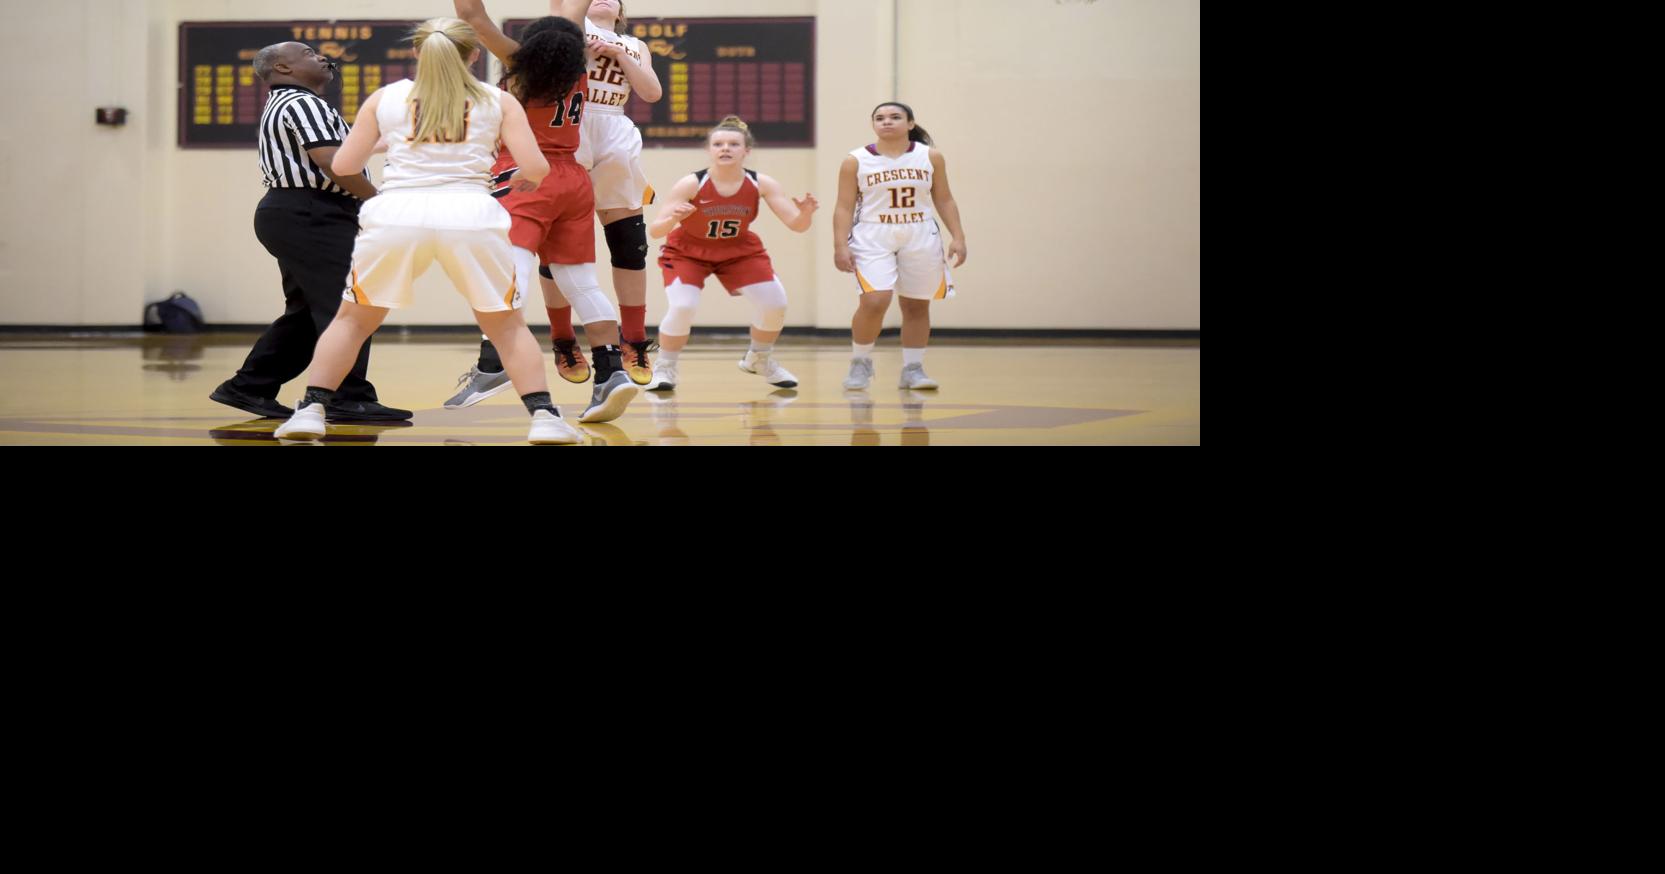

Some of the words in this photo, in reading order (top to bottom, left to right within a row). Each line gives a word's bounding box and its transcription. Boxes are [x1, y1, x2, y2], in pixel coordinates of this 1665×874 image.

[291, 25, 373, 40] TENNIS
[633, 23, 689, 38] GOLF
[589, 55, 625, 86] 32
[584, 87, 626, 106] ALLEY
[550, 90, 584, 127] 14
[866, 168, 930, 187] CRESCENT
[887, 187, 916, 209] 12
[879, 212, 925, 224] VALLEY
[706, 219, 741, 239] 15
